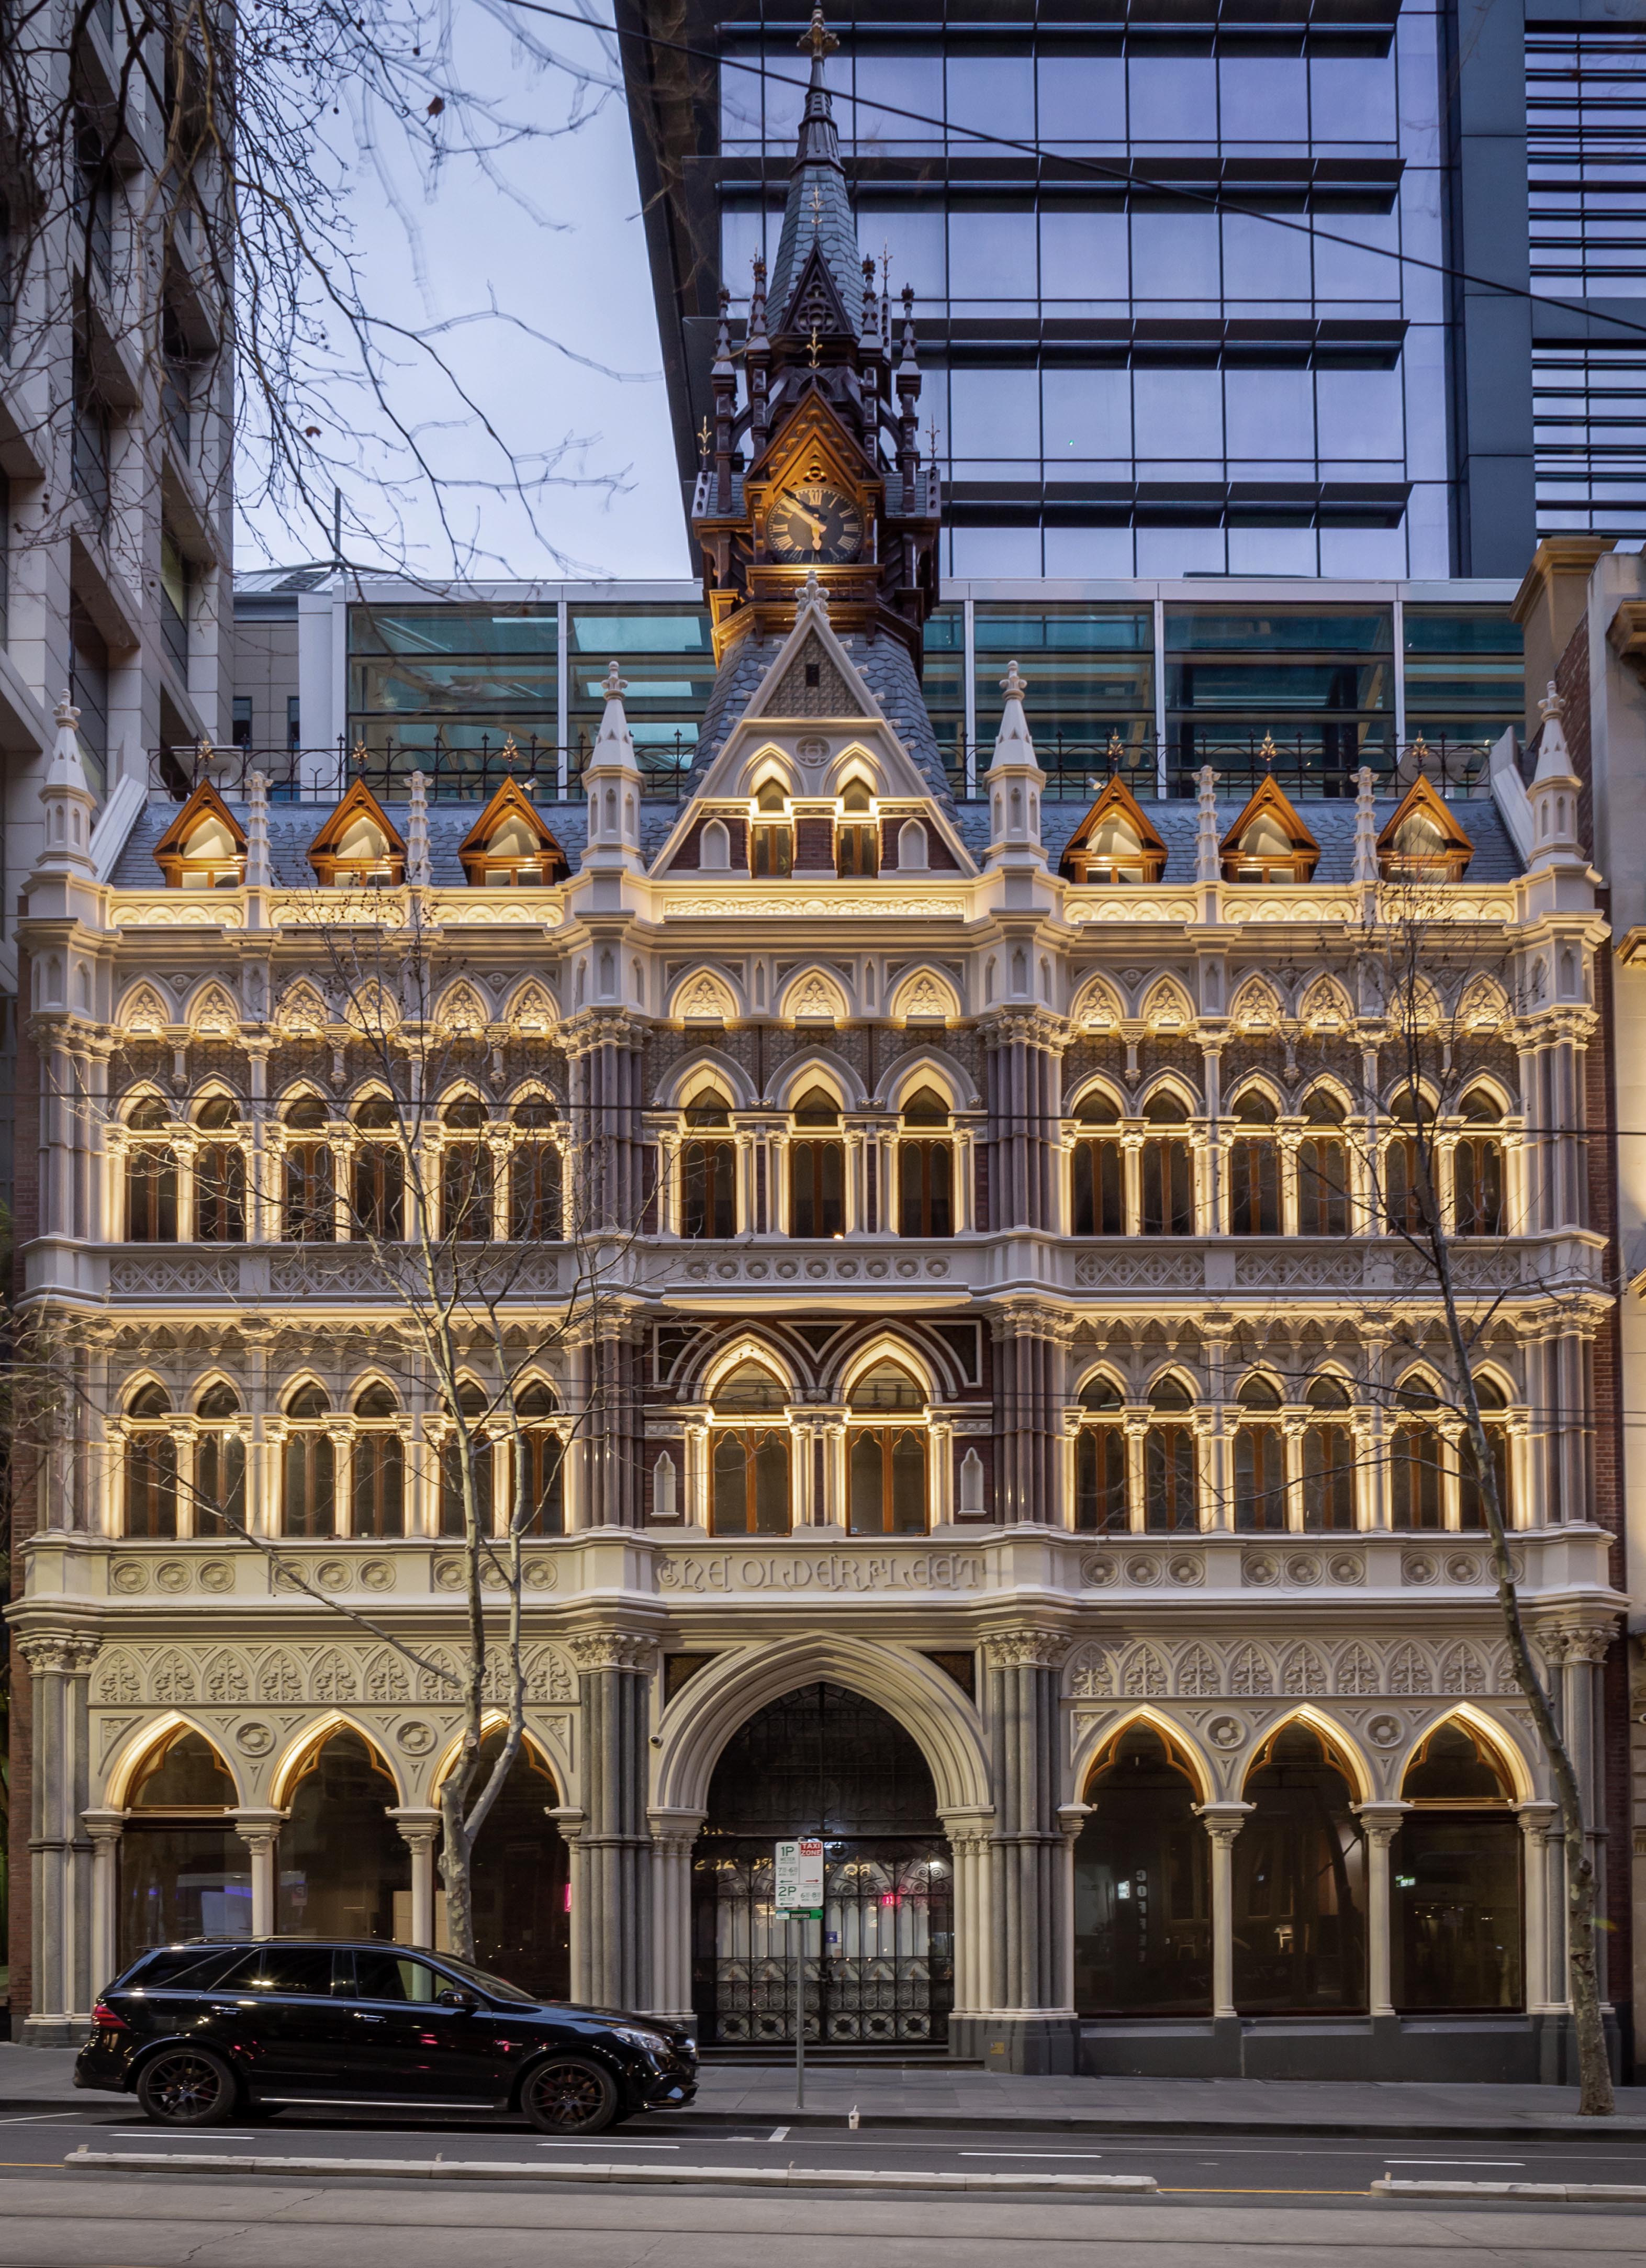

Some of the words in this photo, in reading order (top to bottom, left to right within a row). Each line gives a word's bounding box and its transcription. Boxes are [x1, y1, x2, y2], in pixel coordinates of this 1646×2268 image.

[656, 1555, 733, 1592] THE
[742, 1553, 987, 1592] OLDERFLEET
[781, 1846, 794, 1856] 1P
[778, 1886, 797, 1896] 2P
